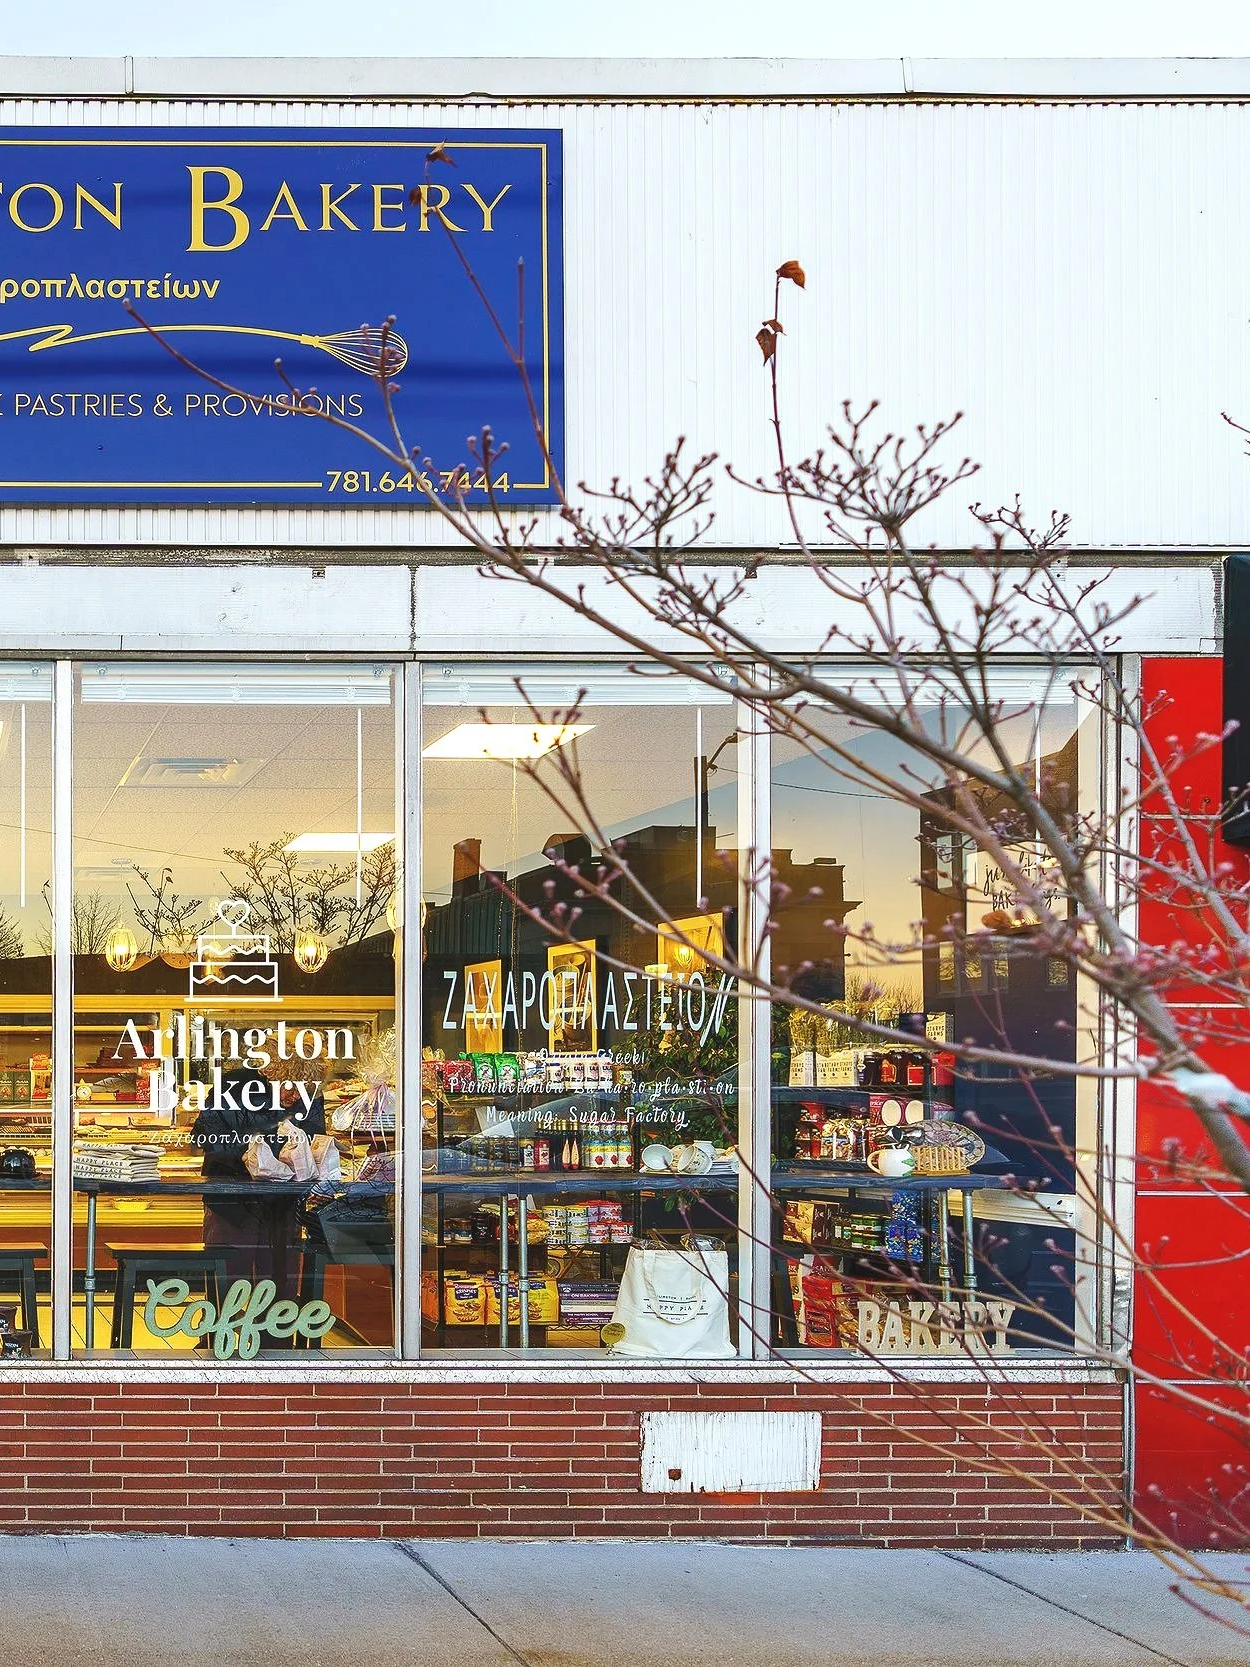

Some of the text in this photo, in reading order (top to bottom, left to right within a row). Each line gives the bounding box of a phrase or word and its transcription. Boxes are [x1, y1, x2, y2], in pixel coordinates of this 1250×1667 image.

[14, 393, 143, 417] PASTRIES
[153, 394, 175, 417] &
[185, 394, 364, 418] PROVISIONS
[326, 470, 511, 493] 781.646.7444
[111, 1015, 357, 1070] Arlington
[148, 1067, 323, 1120] Bakery
[486, 1105, 691, 1131] Meaning: Sugar Factory.
[76, 1157, 98, 1165] HAPPY
[143, 1277, 338, 1360] Coffee
[856, 1301, 1017, 1351] BAKERY
